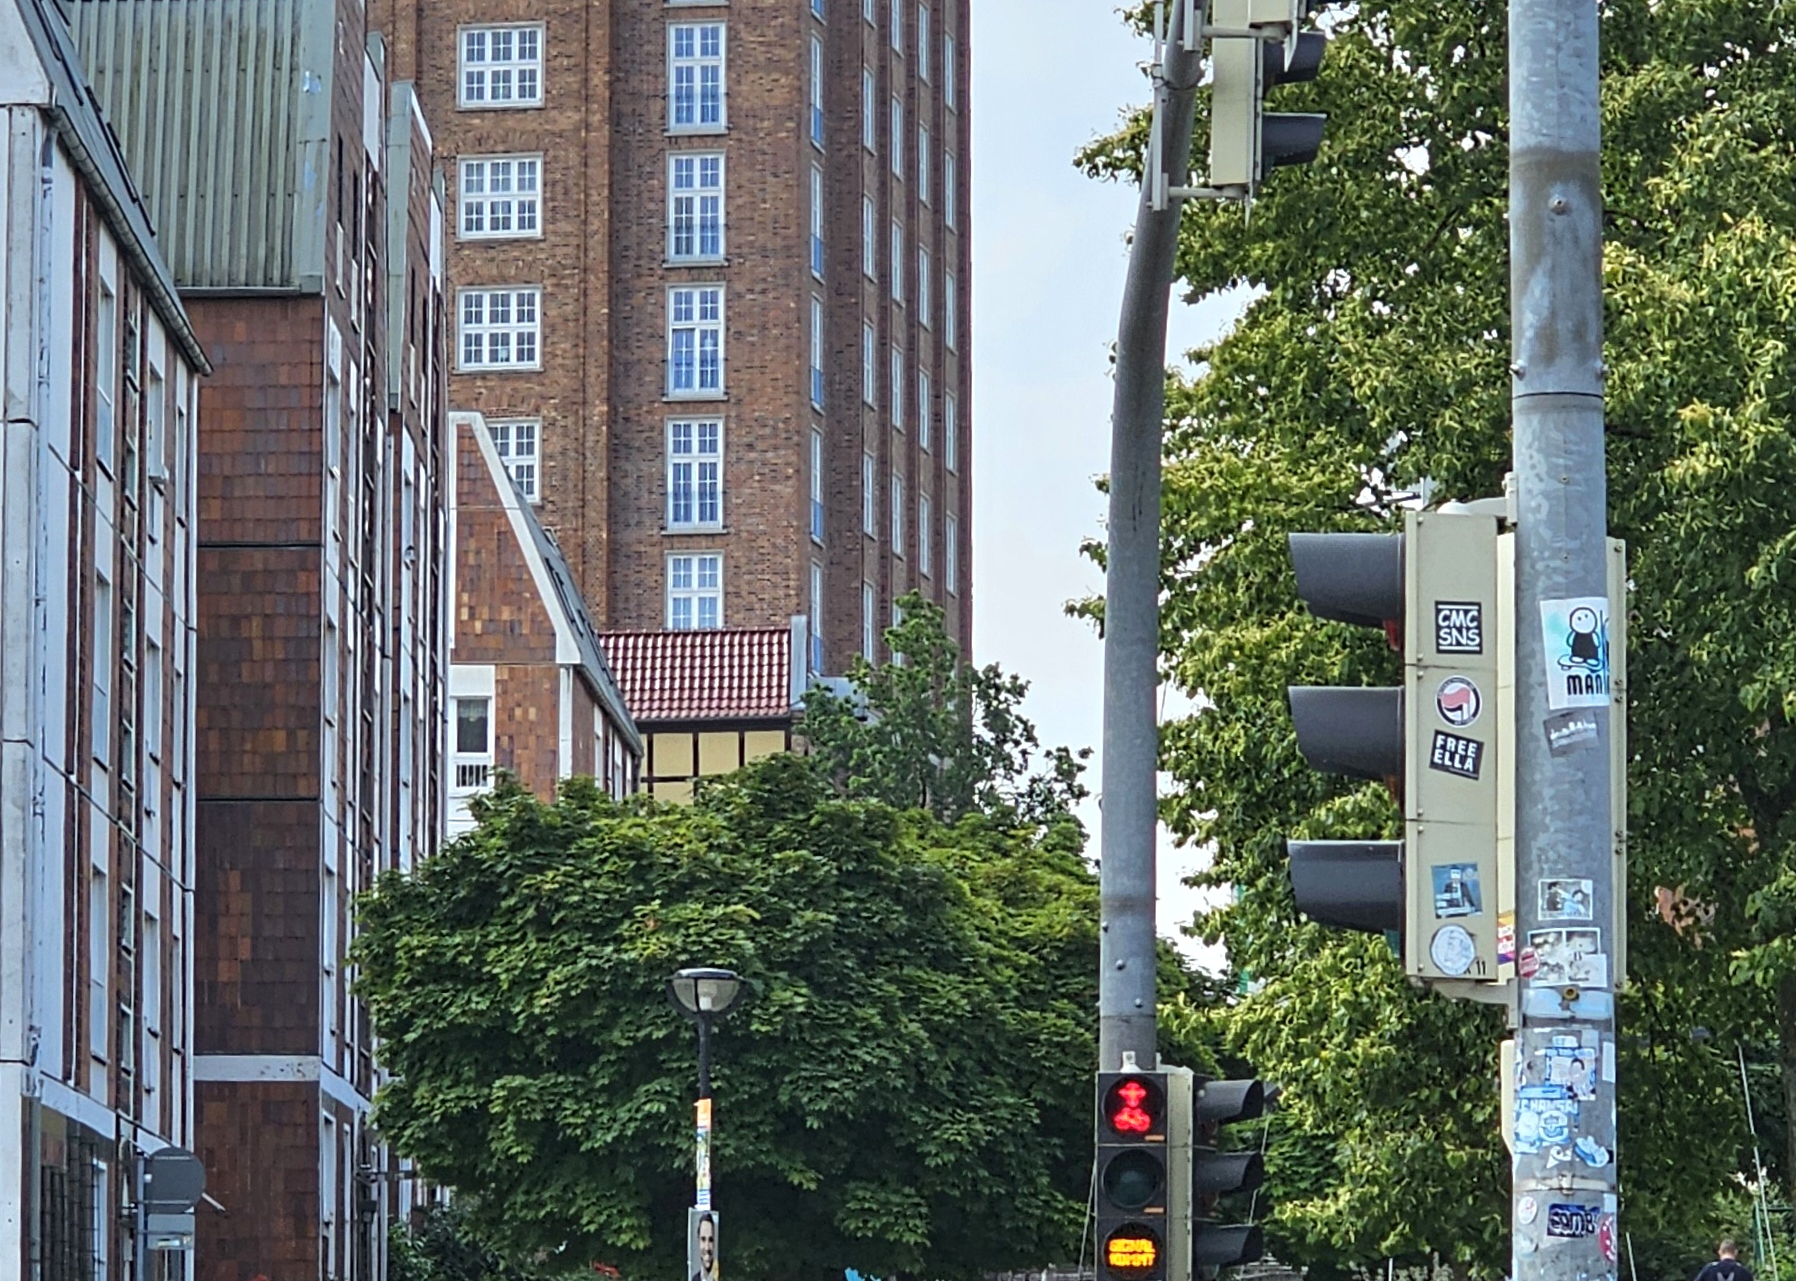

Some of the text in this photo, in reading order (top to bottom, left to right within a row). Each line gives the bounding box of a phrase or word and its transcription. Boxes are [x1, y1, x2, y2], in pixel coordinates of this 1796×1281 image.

[1438, 609, 1479, 628] CMC
[1438, 627, 1481, 646] SNS
[1435, 734, 1478, 758] FREE
[1433, 748, 1475, 773] ELLA
